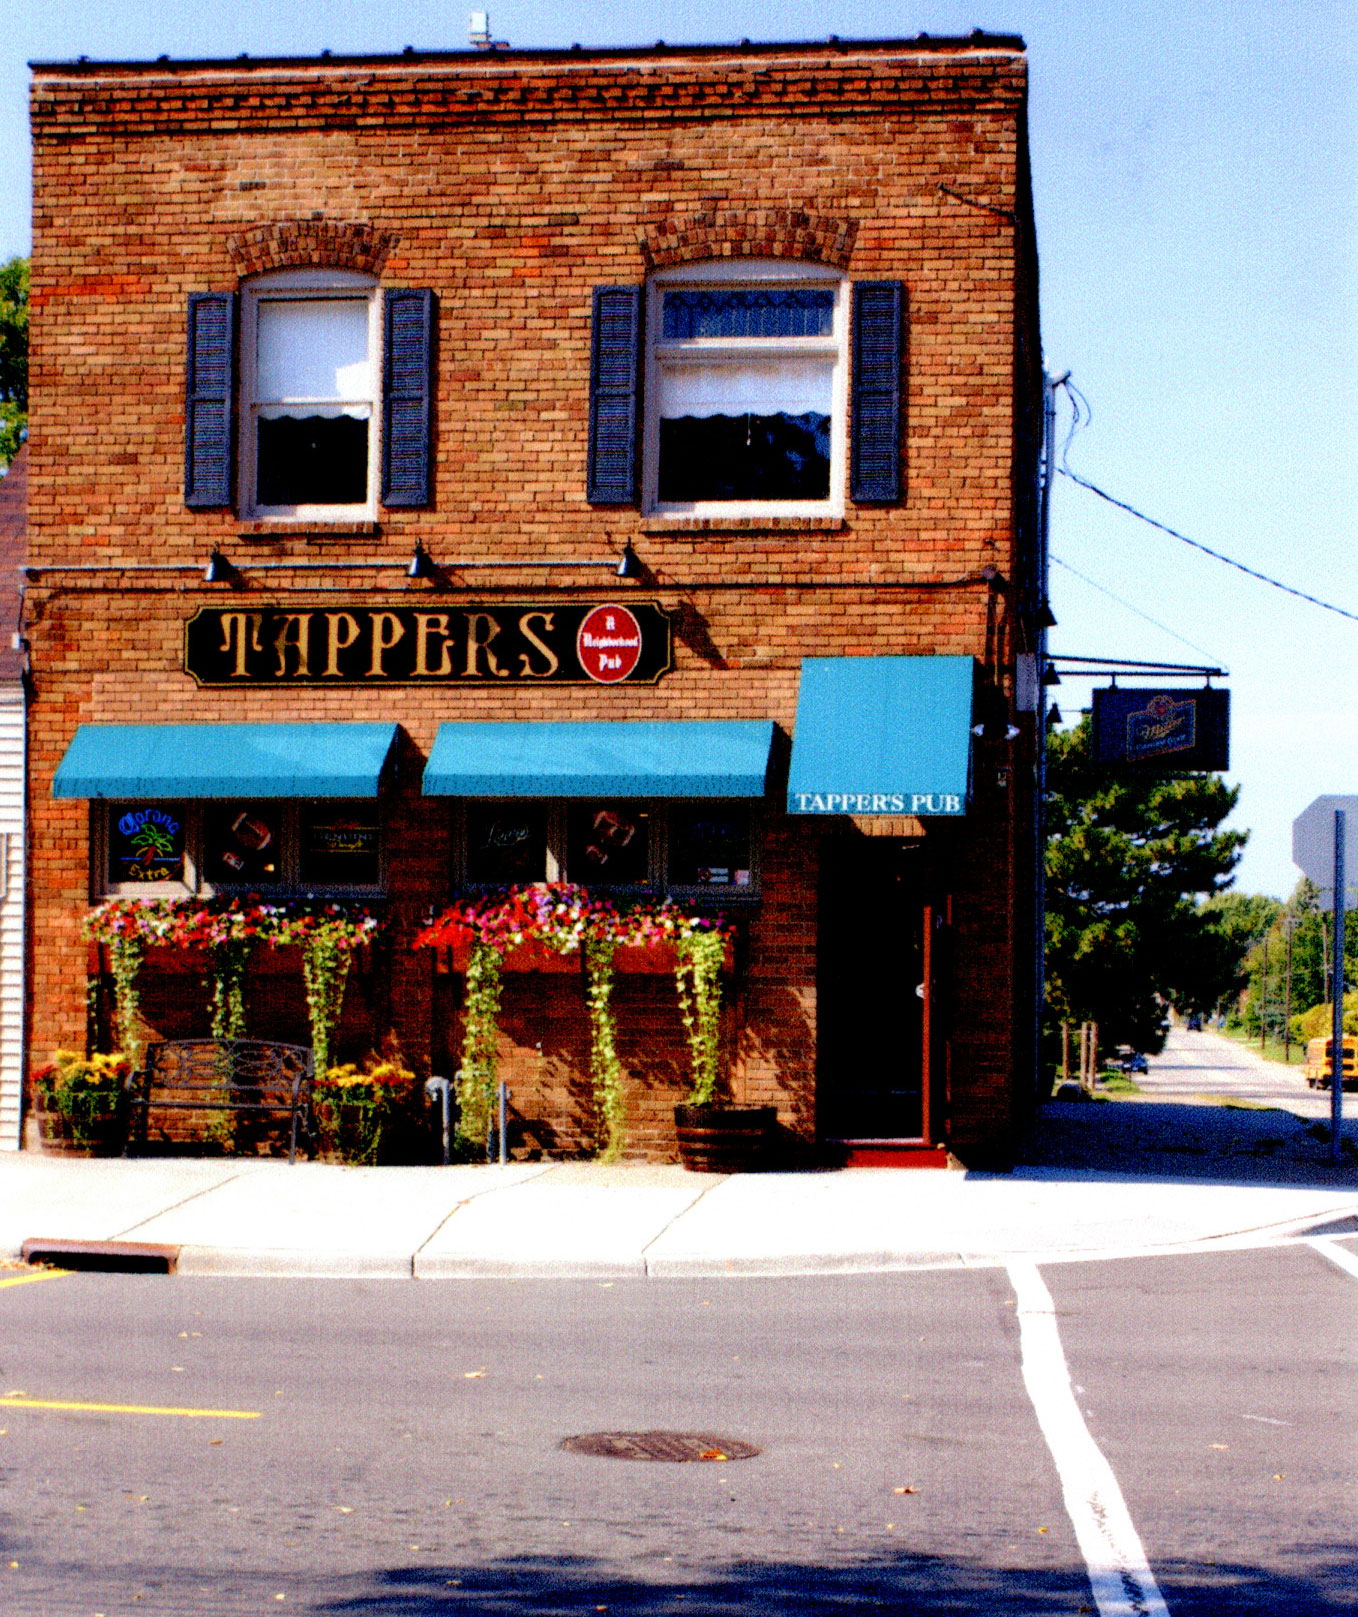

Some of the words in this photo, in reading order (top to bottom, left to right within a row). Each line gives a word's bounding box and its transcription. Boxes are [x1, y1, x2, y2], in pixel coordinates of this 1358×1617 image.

[220, 612, 559, 677] TAPPERS
[583, 632, 639, 649] Neighborhood
[598, 653, 622, 672] Pub
[795, 793, 905, 811] TAPPER'S
[911, 794, 960, 812] PUB
[118, 808, 180, 836] Corona
[128, 863, 170, 881] Extra
